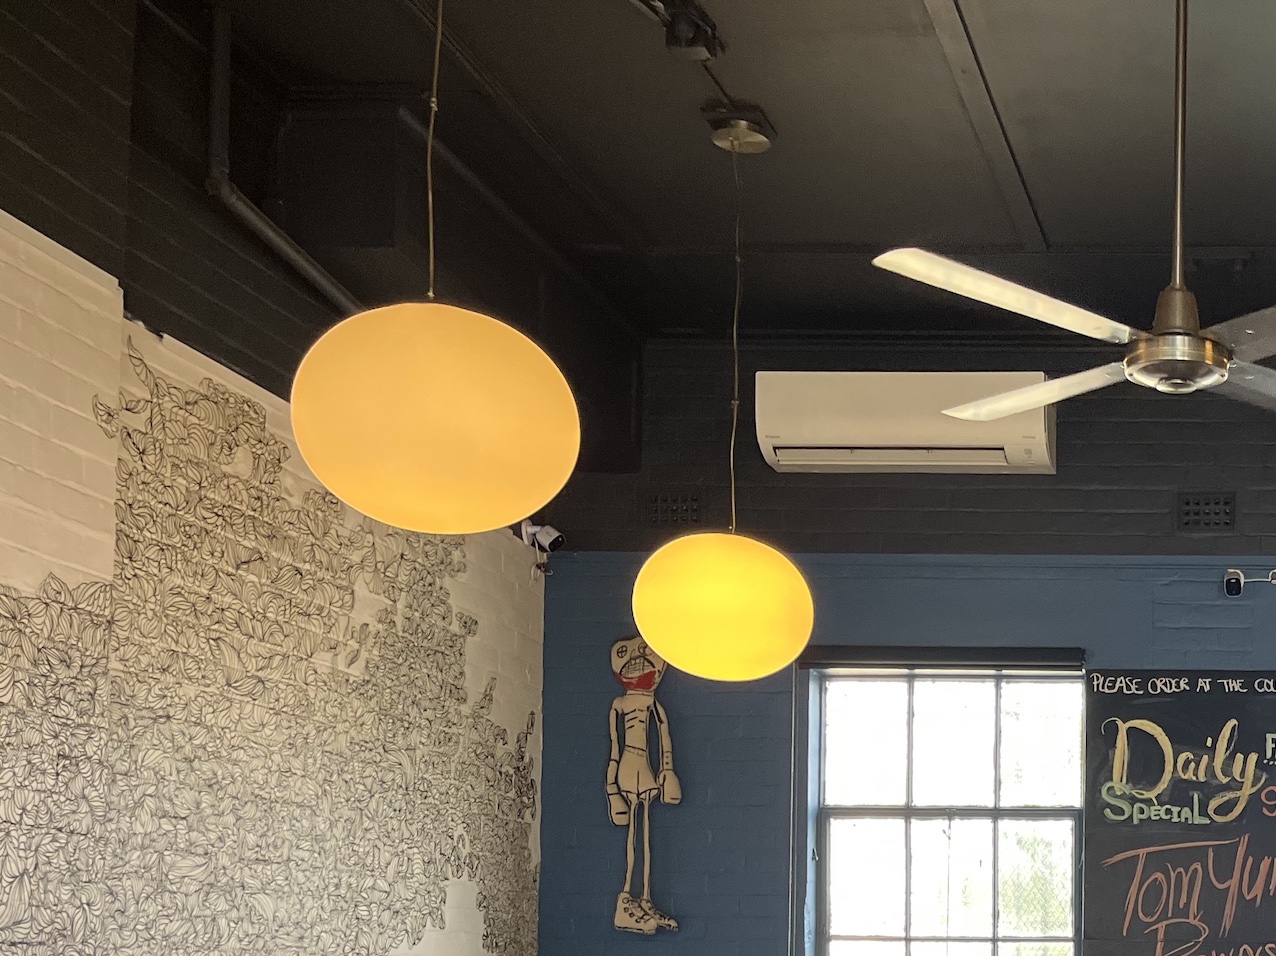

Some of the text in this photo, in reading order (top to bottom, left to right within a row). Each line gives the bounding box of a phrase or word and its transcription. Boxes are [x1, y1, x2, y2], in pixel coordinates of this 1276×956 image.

[1089, 672, 1144, 695] PLEASE
[1148, 677, 1190, 695] ORDER
[1197, 678, 1213, 693] AT
[1217, 678, 1248, 693] THE
[1101, 717, 1266, 823] Daily
